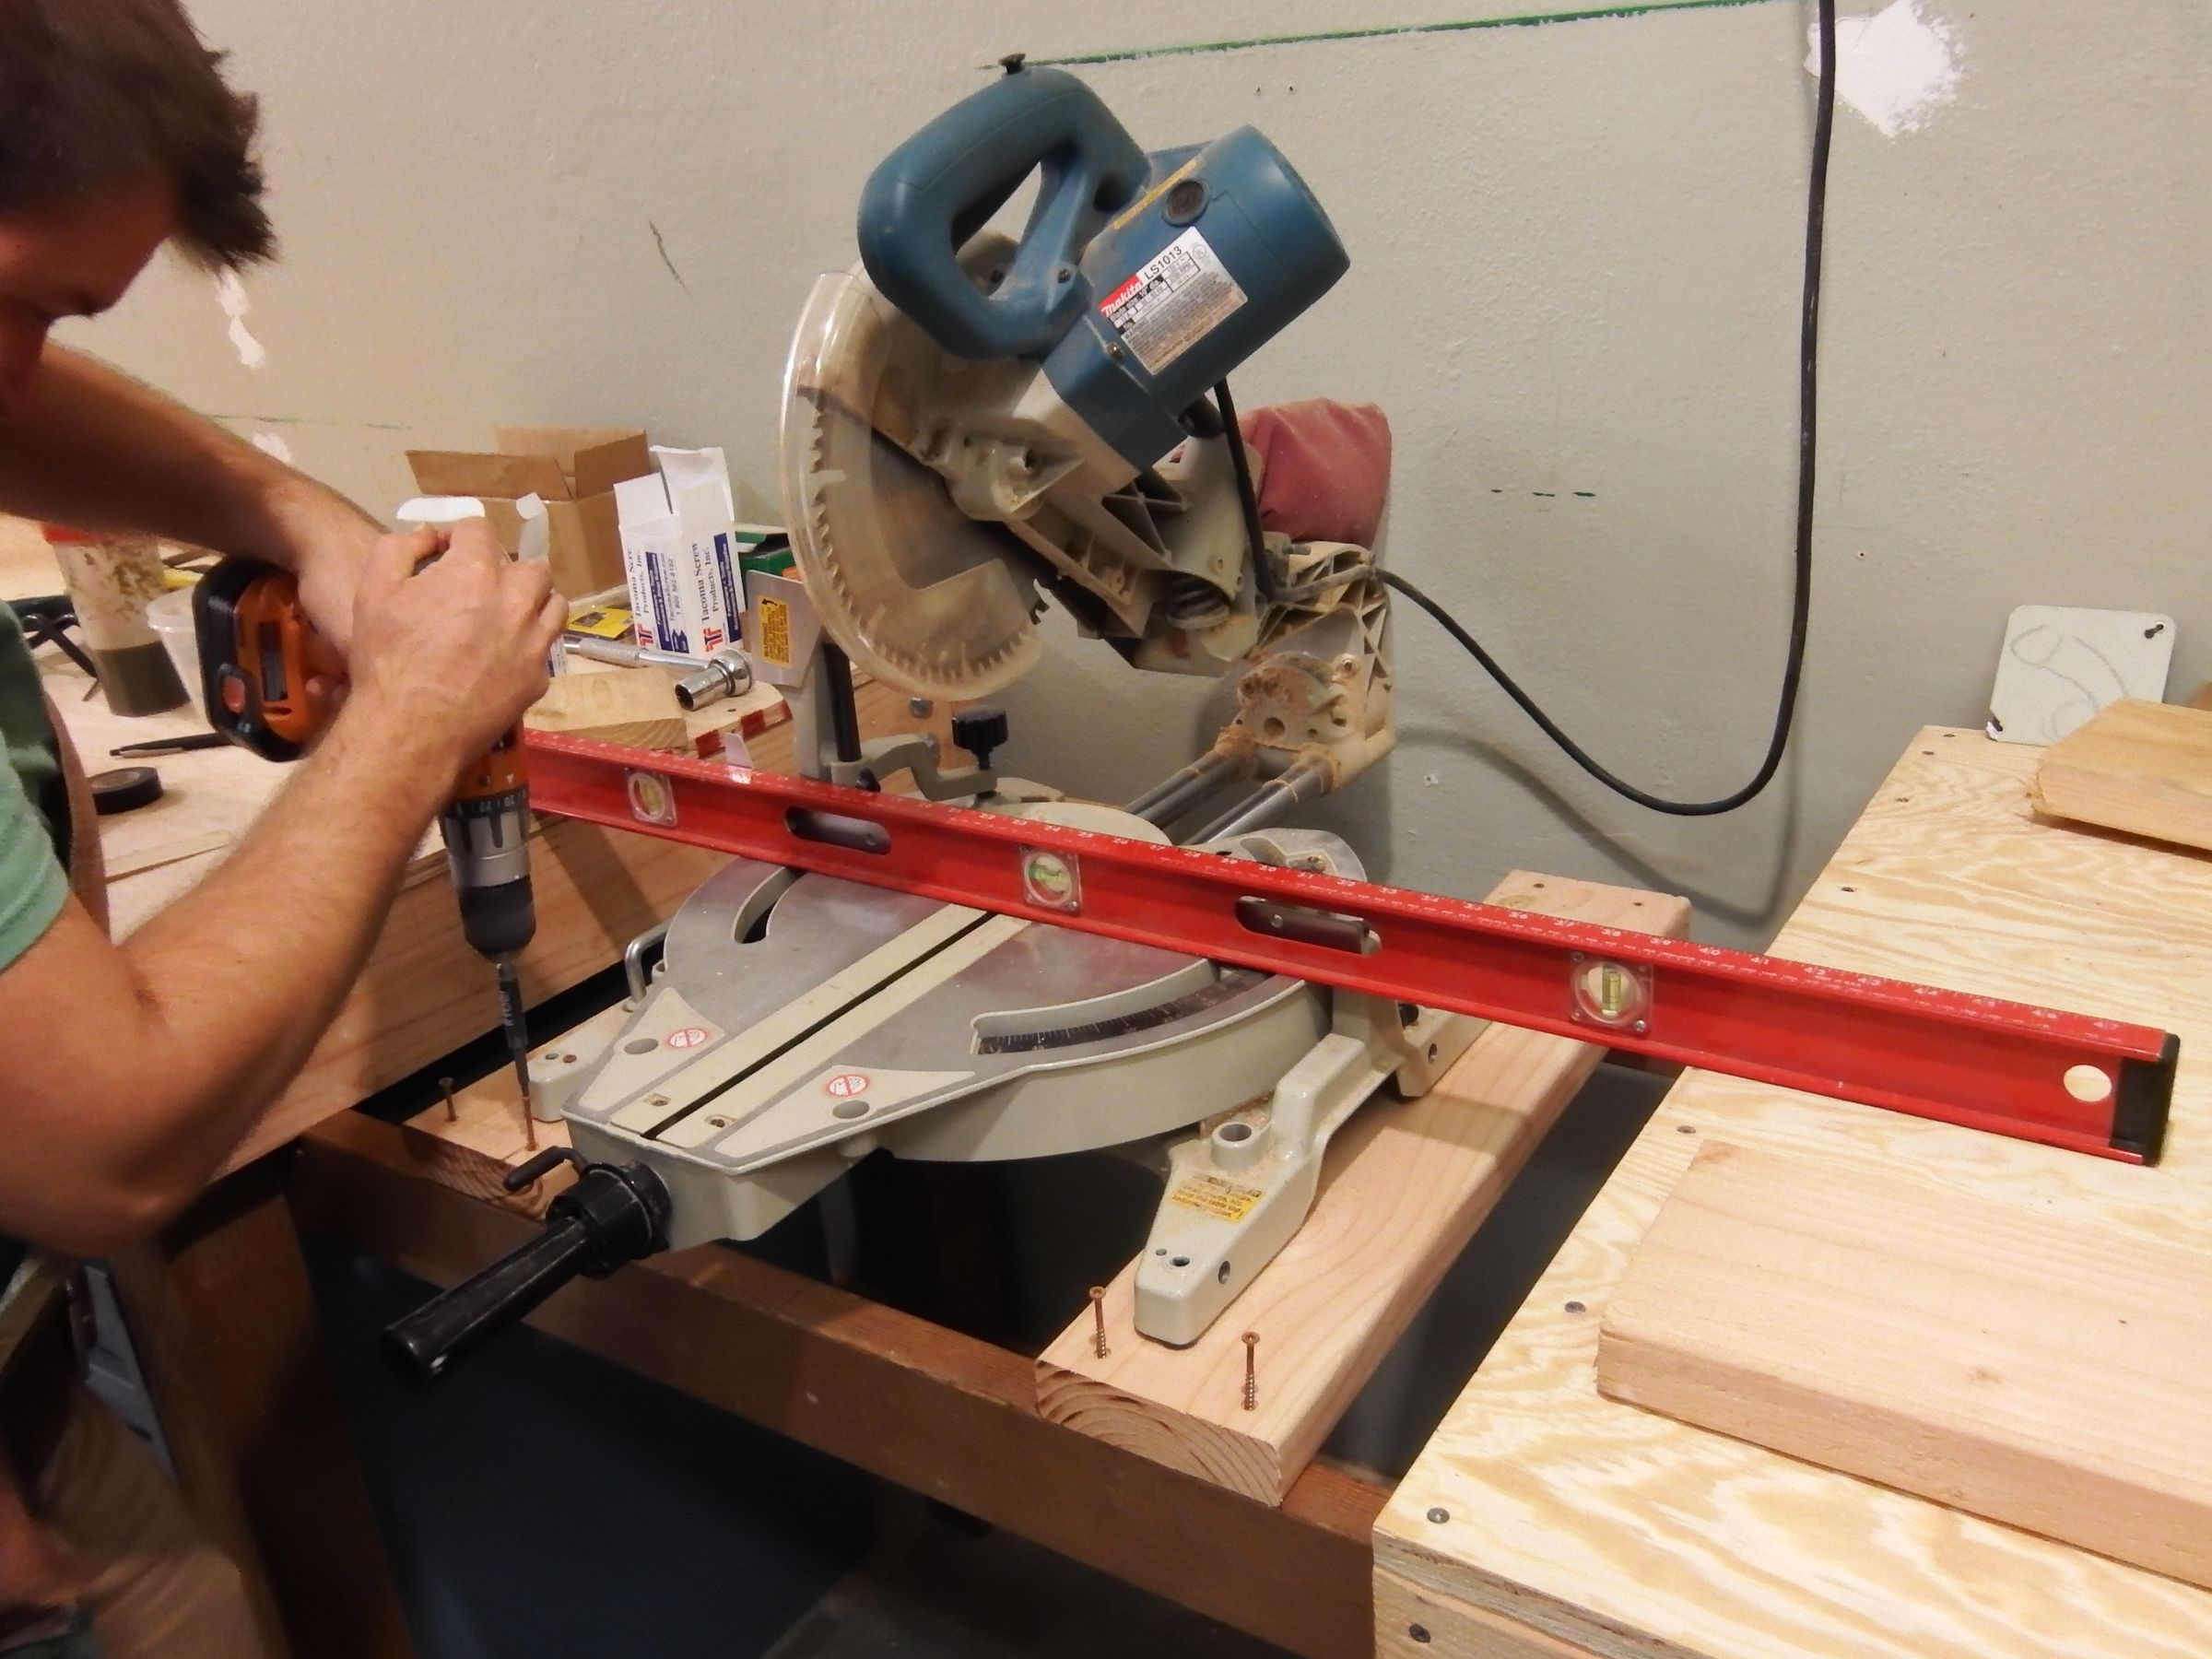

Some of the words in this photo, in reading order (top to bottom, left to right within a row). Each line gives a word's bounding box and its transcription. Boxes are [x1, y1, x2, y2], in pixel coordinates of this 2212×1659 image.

[1144, 246, 1182, 280] LS1013
[691, 542, 702, 577] Screw
[631, 576, 642, 618] Tacoma
[698, 579, 710, 621] Tacoma
[1601, 927, 1622, 937] 38
[1699, 947, 1721, 956] 40
[1750, 956, 1770, 966] 41
[1804, 966, 1826, 976] 42
[1857, 976, 1881, 986] 43
[2031, 1008, 2058, 1019] 46
